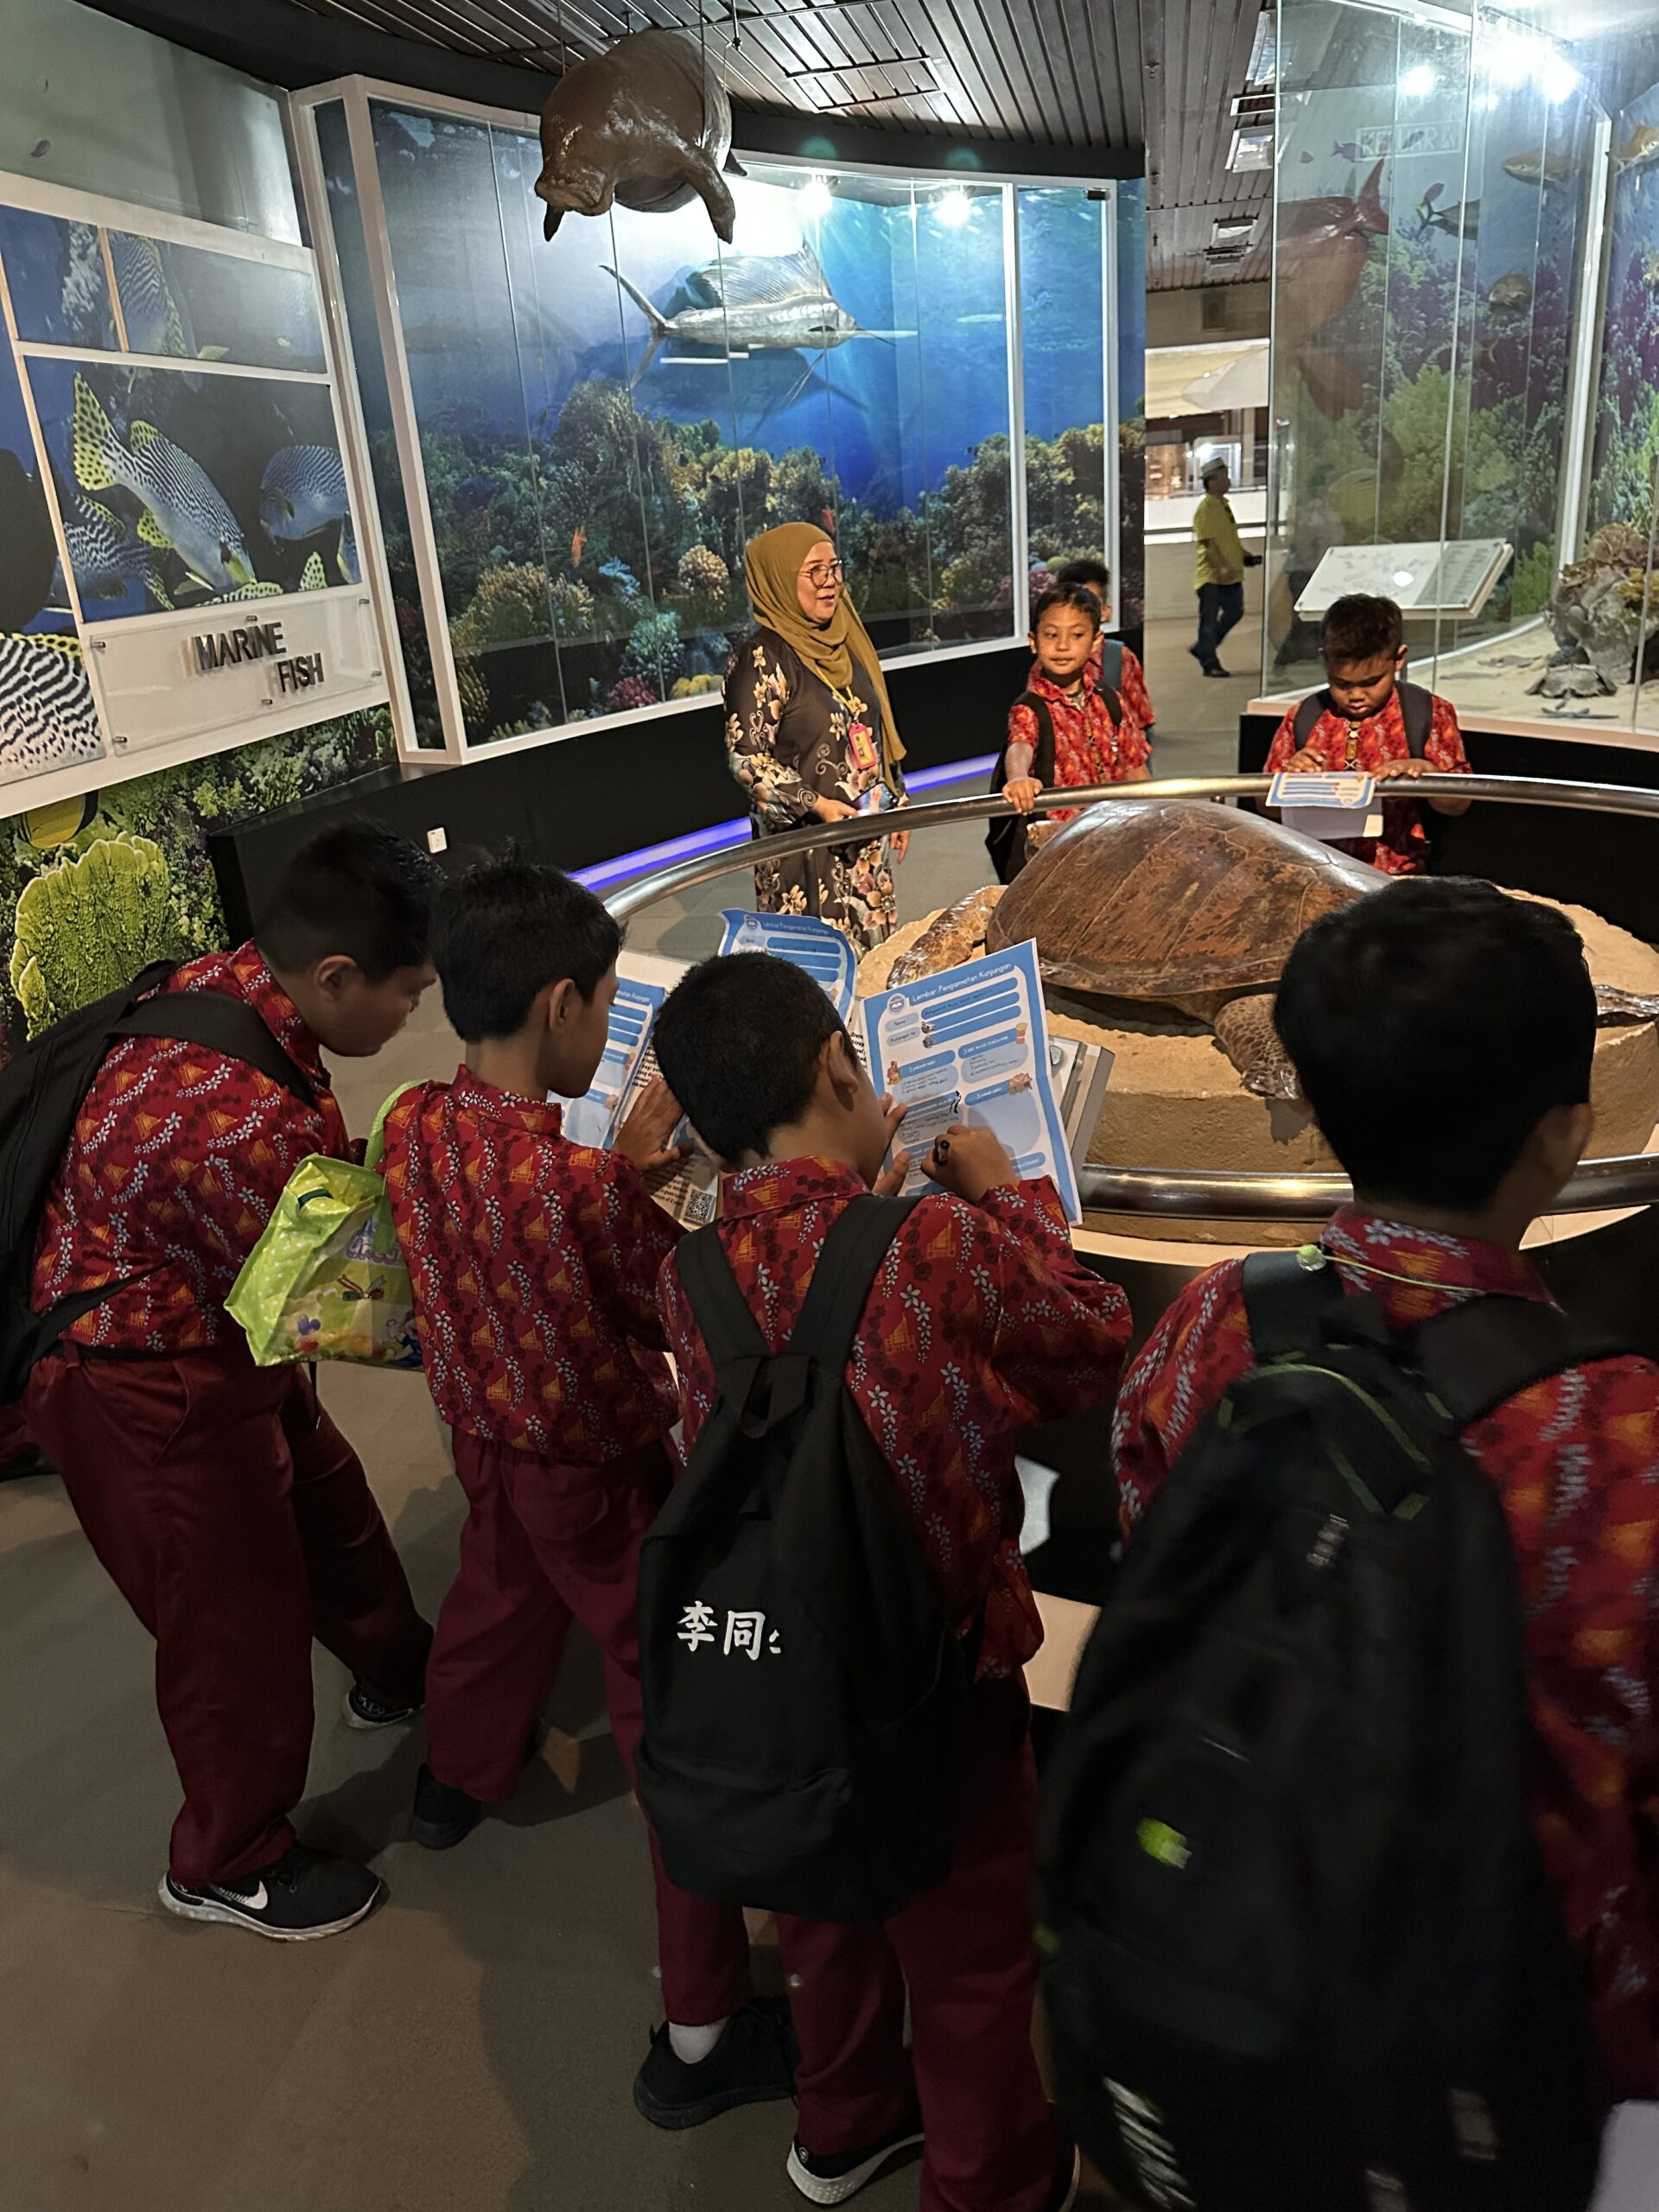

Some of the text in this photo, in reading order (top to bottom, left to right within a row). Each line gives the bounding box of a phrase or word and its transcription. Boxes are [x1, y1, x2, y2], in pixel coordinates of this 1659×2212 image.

[193, 621, 287, 671] MARINE
[276, 652, 324, 692] FISH
[912, 988, 937, 1002] Lembar
[938, 975, 978, 995] Pengamatan
[979, 963, 1011, 978] Kunjungan
